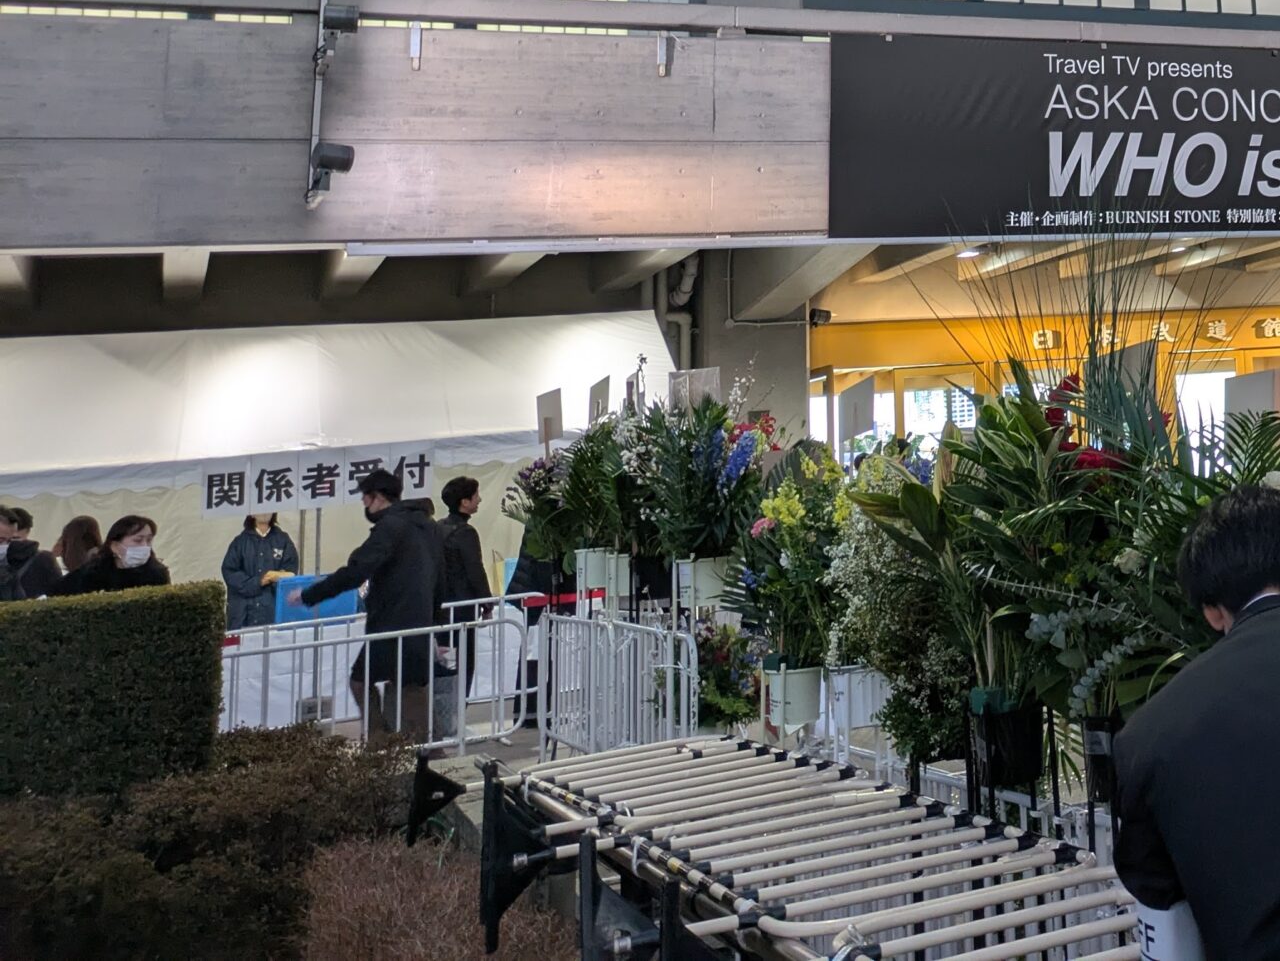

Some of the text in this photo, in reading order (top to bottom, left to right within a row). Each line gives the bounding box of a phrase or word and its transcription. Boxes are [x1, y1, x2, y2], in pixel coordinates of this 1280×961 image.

[1043, 54, 1233, 80] Travel TV presents
[1044, 84, 1158, 120] ASKA
[1048, 132, 1228, 198] WHO
[1174, 209, 1221, 223] STONE
[206, 452, 431, 510] 関係者受付
